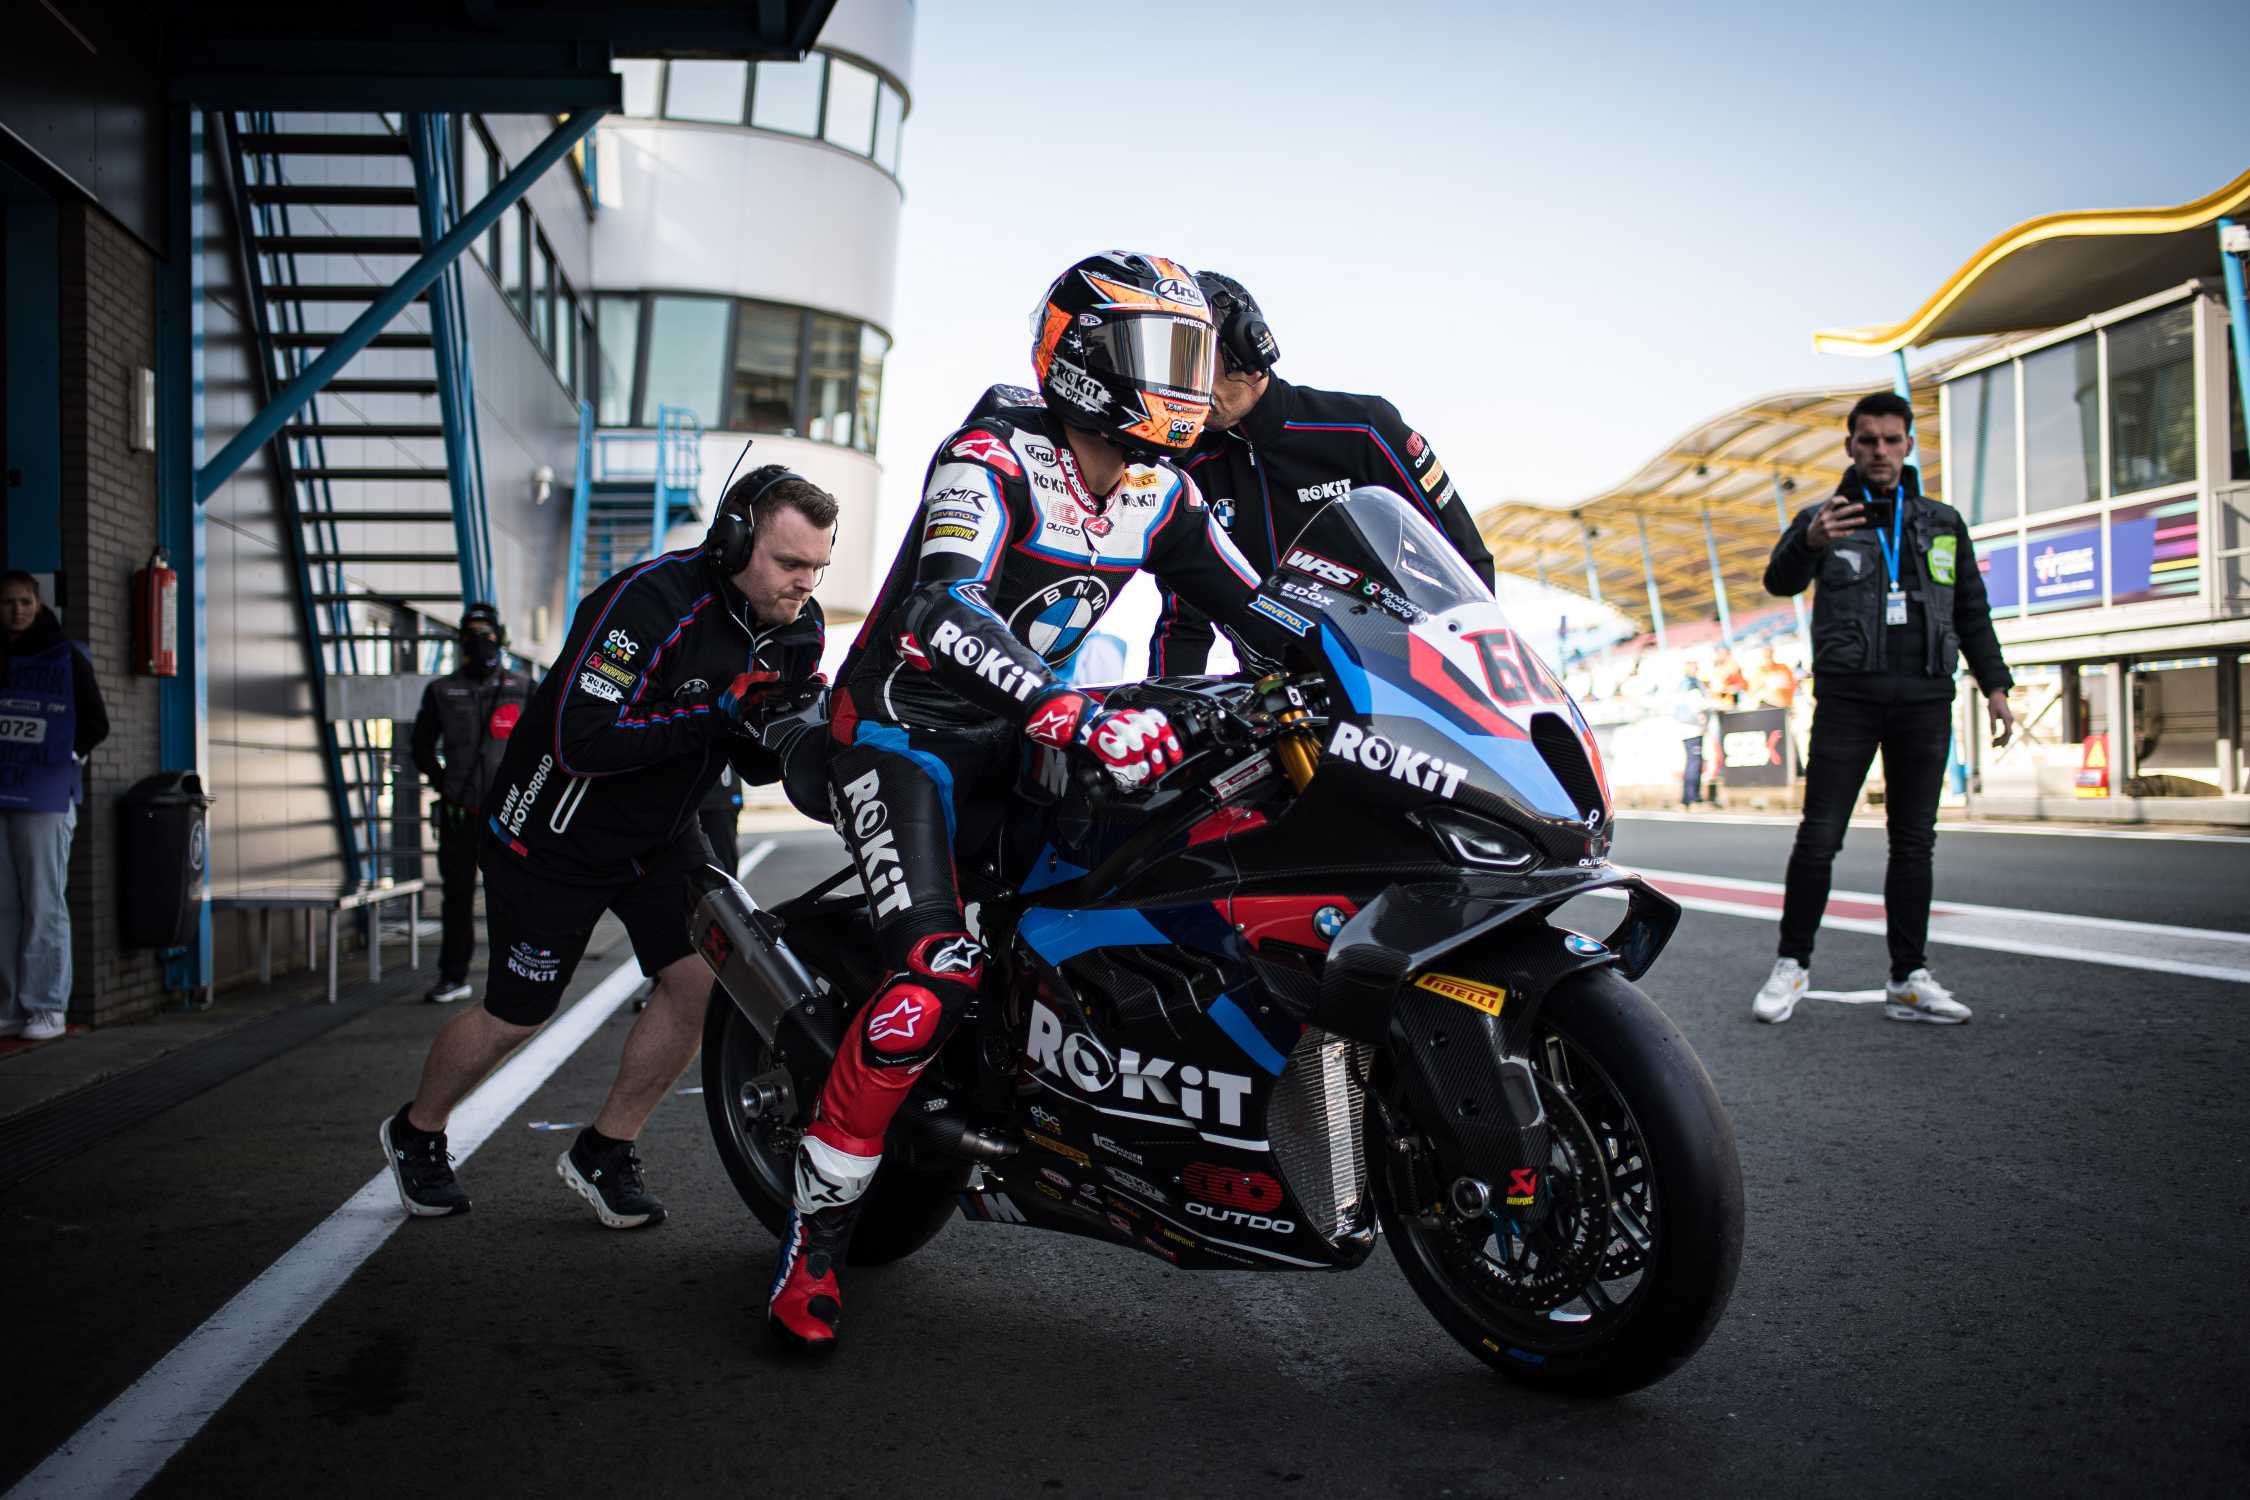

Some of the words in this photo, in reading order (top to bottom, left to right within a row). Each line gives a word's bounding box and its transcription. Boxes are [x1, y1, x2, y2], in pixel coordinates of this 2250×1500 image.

[1027, 446, 1056, 463] Arai
[1297, 478, 1351, 503] ROKiT
[1046, 522, 1081, 537] OUTDO
[1287, 550, 1359, 585] WRS
[1281, 582, 1335, 606] EDOX
[1257, 600, 1304, 630] RAVENOL
[608, 629, 639, 655] ebc
[929, 619, 1044, 702] ROKiT
[1328, 721, 1468, 799] ROKiT
[499, 784, 520, 826] BMW
[509, 754, 553, 836] MOTORRAD
[843, 768, 912, 919] ROKiT
[507, 957, 558, 981] ROKiT
[1422, 975, 1499, 1009] PIRELLI
[1026, 999, 1252, 1127] ROKiT
[1184, 1201, 1296, 1234] OUTDO
